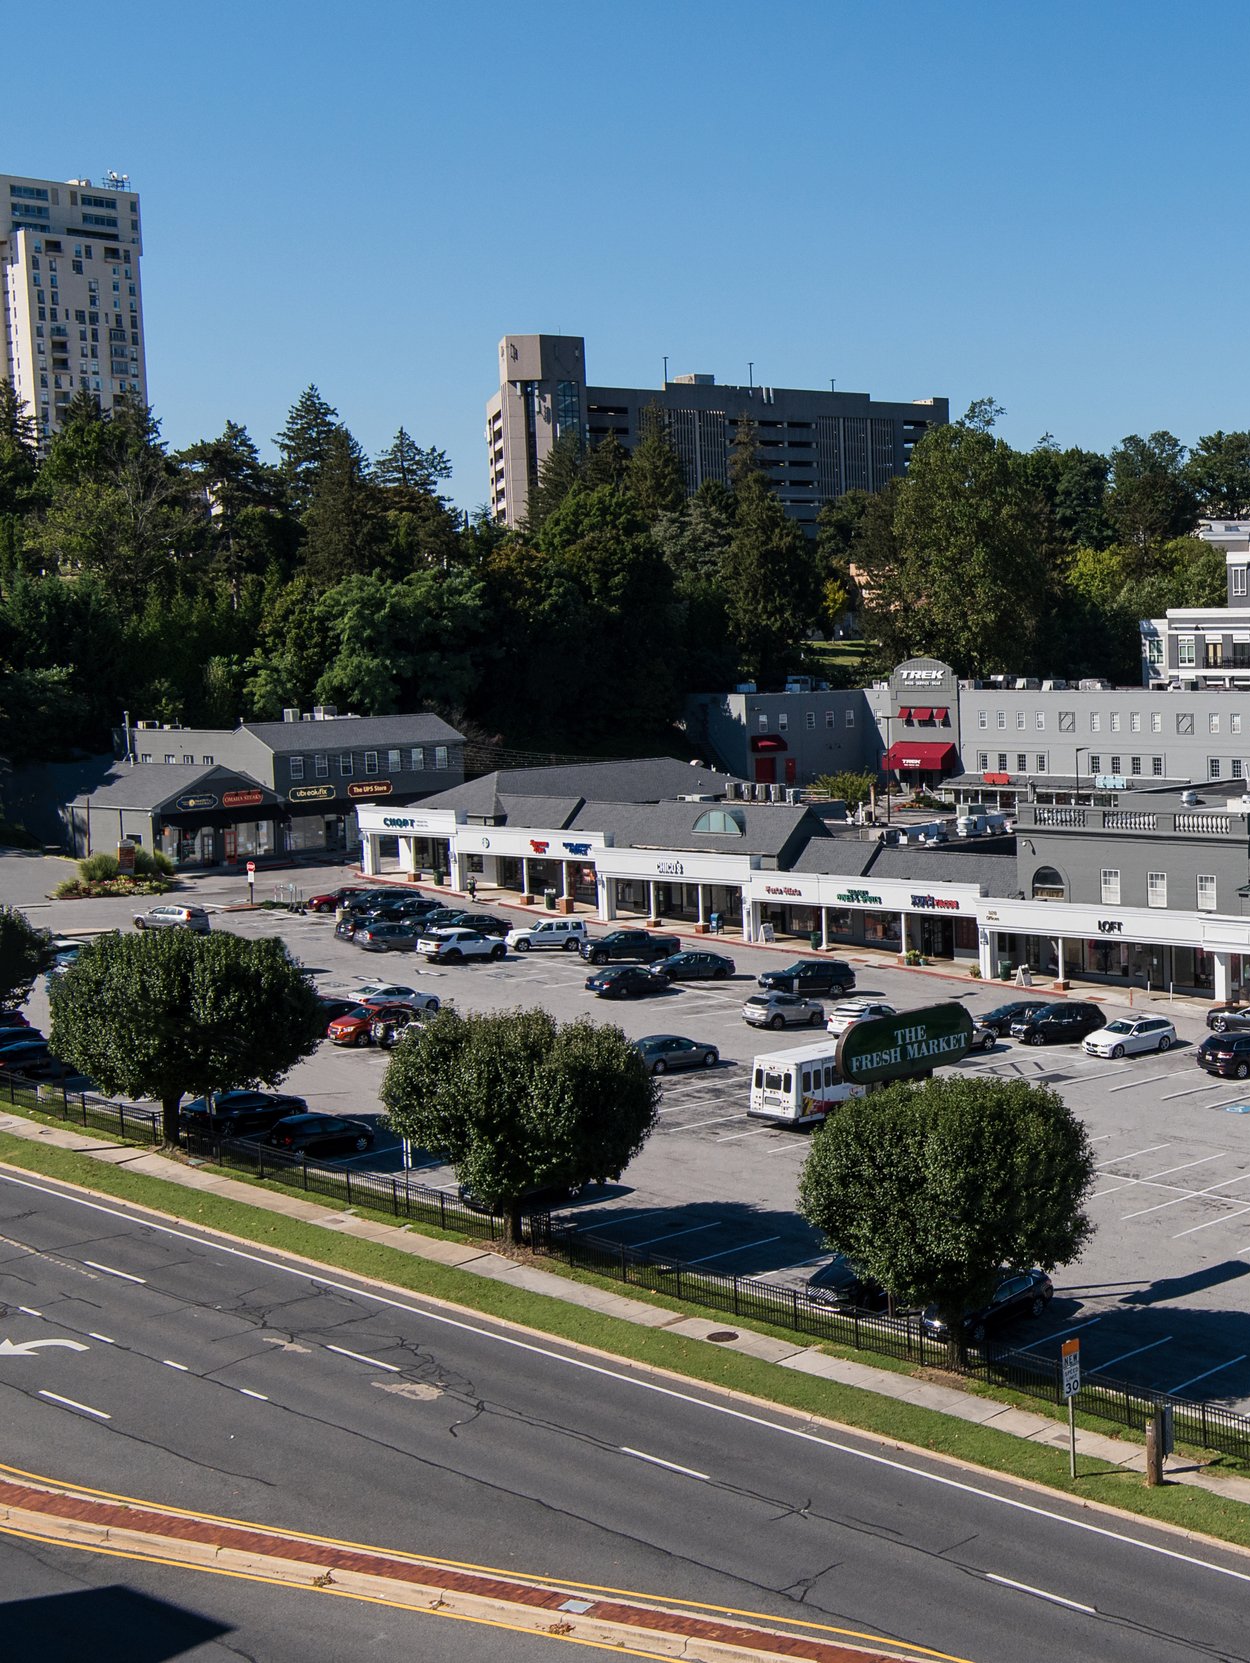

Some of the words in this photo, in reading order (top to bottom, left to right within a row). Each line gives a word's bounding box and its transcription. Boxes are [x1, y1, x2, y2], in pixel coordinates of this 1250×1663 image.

[900, 670, 945, 679] TREK
[1098, 920, 1124, 934] LOFT
[893, 1025, 926, 1045] THE
[851, 1047, 901, 1073] FRESH
[906, 1031, 967, 1060] MARKET
[1064, 1353, 1078, 1365] NEW
[1065, 1367, 1079, 1377] SPEED
[1065, 1379, 1079, 1394] 30
